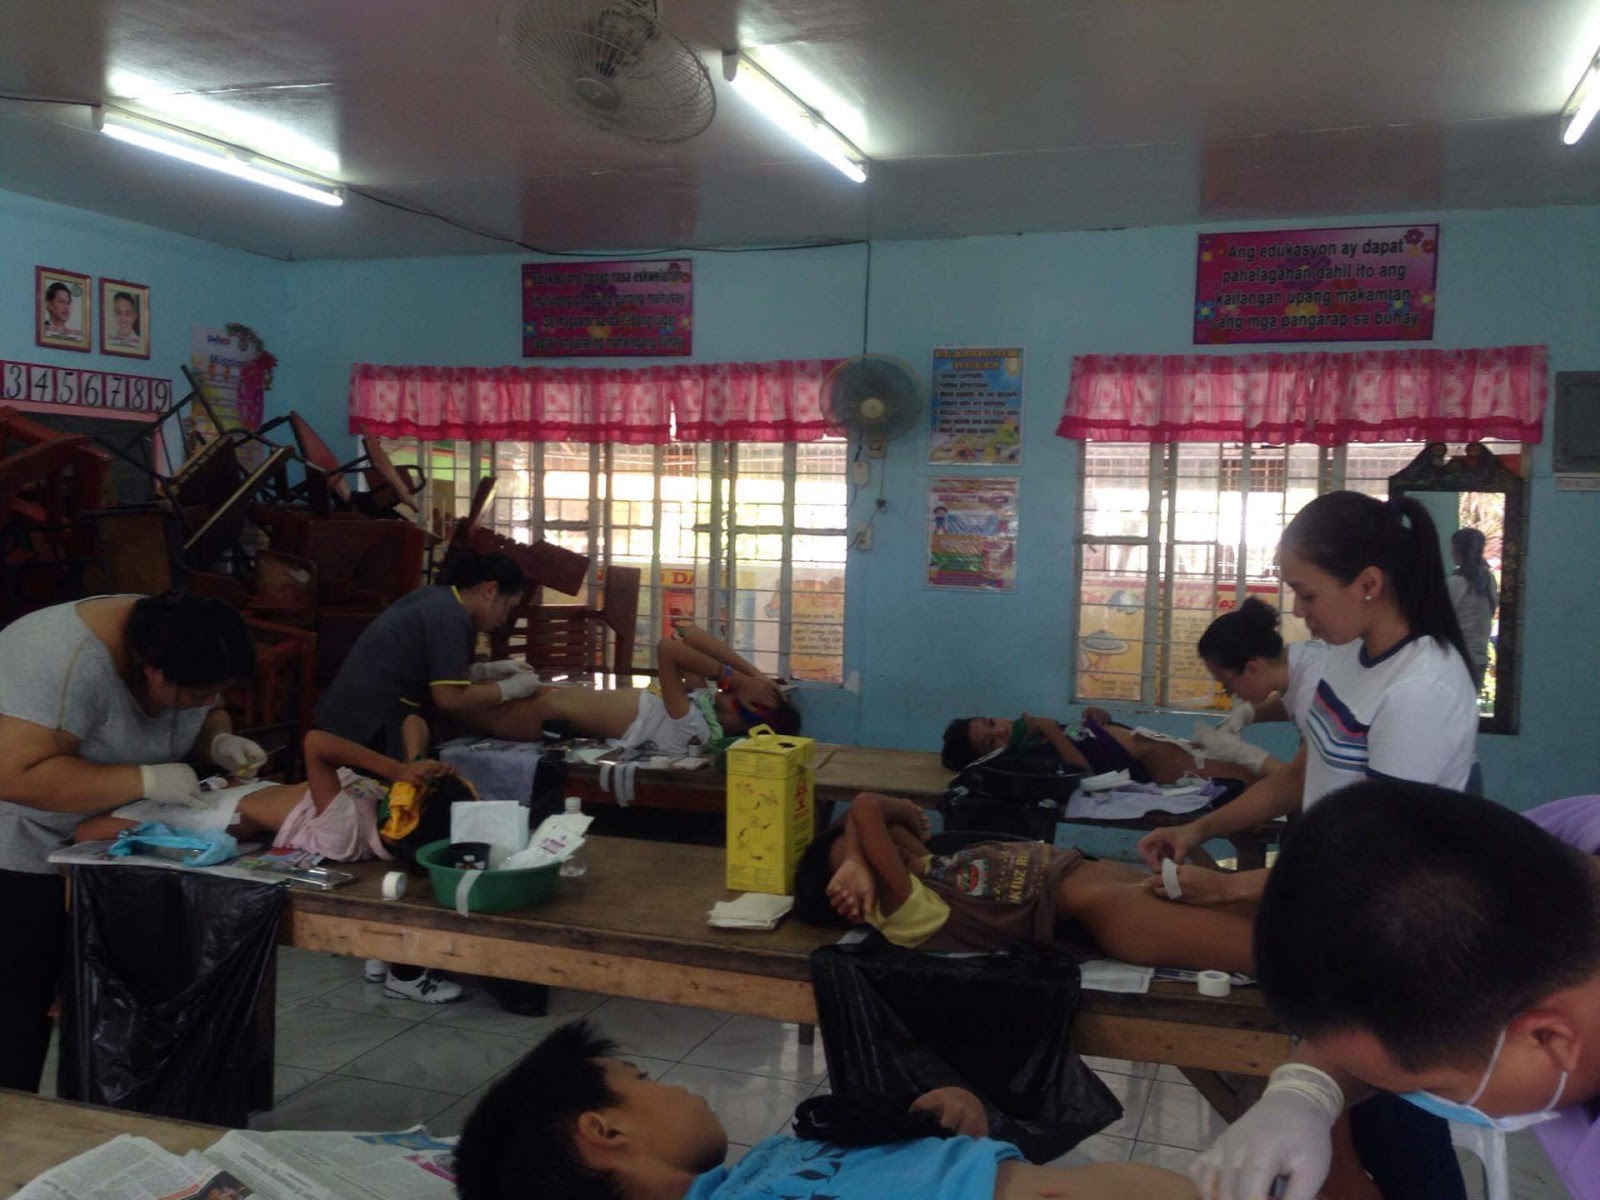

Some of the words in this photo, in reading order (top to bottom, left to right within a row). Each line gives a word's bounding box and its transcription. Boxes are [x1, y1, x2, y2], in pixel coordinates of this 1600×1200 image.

[1228, 244, 1255, 263] Ang
[1260, 240, 1336, 261] edukasyon
[1341, 242, 1357, 259] ay
[1362, 238, 1404, 258] dapat
[1222, 265, 1312, 285] pahalagahan
[1316, 264, 1351, 281] dahil
[1355, 264, 1374, 280] ito
[1379, 264, 1407, 281] ang
[1216, 291, 1282, 309] kailangan
[1287, 289, 1331, 308] upang
[1336, 287, 1411, 303] makamtan
[1218, 314, 1244, 331] ang
[1248, 314, 1277, 331] mga
[1281, 313, 1348, 331] pangarap
[1353, 313, 1369, 326] sa
[1375, 311, 1419, 328] buhay
[6, 365, 22, 399] 3
[33, 370, 49, 400] 4
[59, 371, 74, 404] 5
[84, 374, 99, 406] 6
[110, 377, 124, 408] 7
[132, 379, 145, 410] 8
[154, 381, 169, 412] 9
